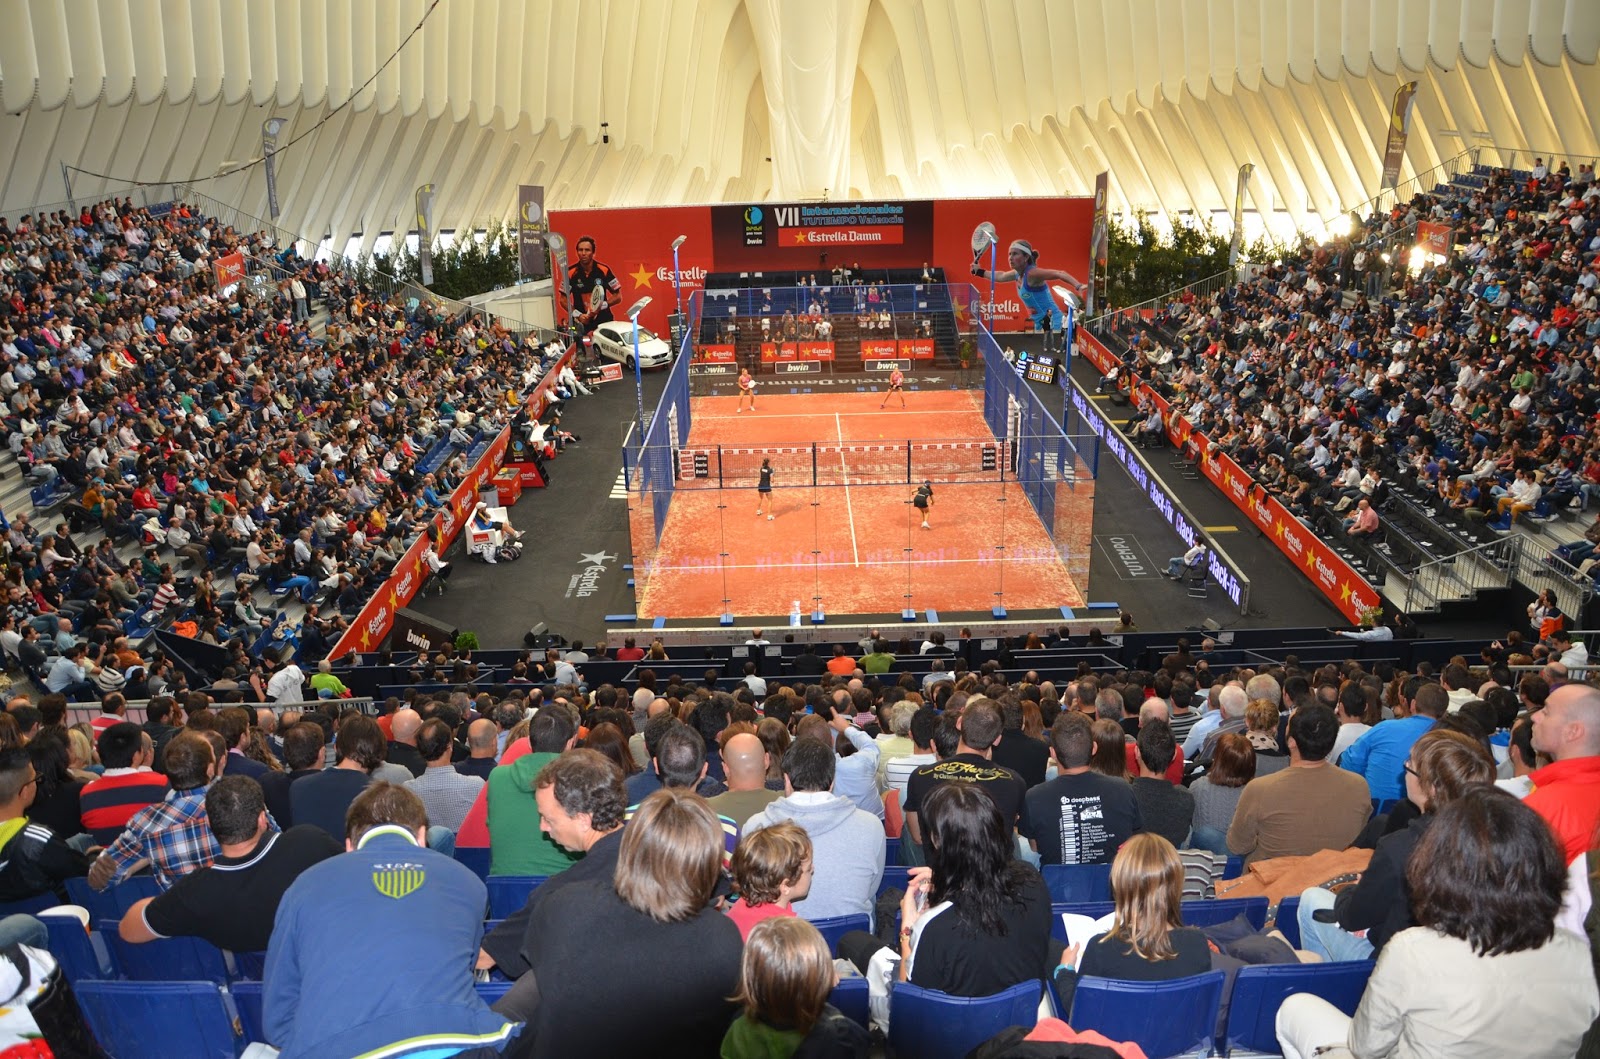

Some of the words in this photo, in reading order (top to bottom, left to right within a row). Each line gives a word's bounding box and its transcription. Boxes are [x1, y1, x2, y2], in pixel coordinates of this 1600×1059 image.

[774, 207, 799, 227] VII
[802, 204, 904, 216] Internacionales
[802, 216, 857, 226] TUTEMPO
[858, 214, 904, 225] Valencia
[808, 230, 848, 242] Estrella
[848, 230, 882, 242] Damm
[656, 266, 707, 281] Esrella
[787, 362, 809, 371] bwin
[1231, 475, 1246, 497] Estrella
[1255, 499, 1272, 523] Estrella
[1284, 526, 1303, 553] Estrella
[1109, 537, 1147, 577] TUTEMPO
[1315, 556, 1337, 585] Estrella
[396, 571, 412, 596] Estrella
[576, 565, 607, 598] Estrella
[368, 606, 387, 634] Estrella
[407, 629, 431, 650] bwin
[1071, 796, 1101, 804] deepbass
